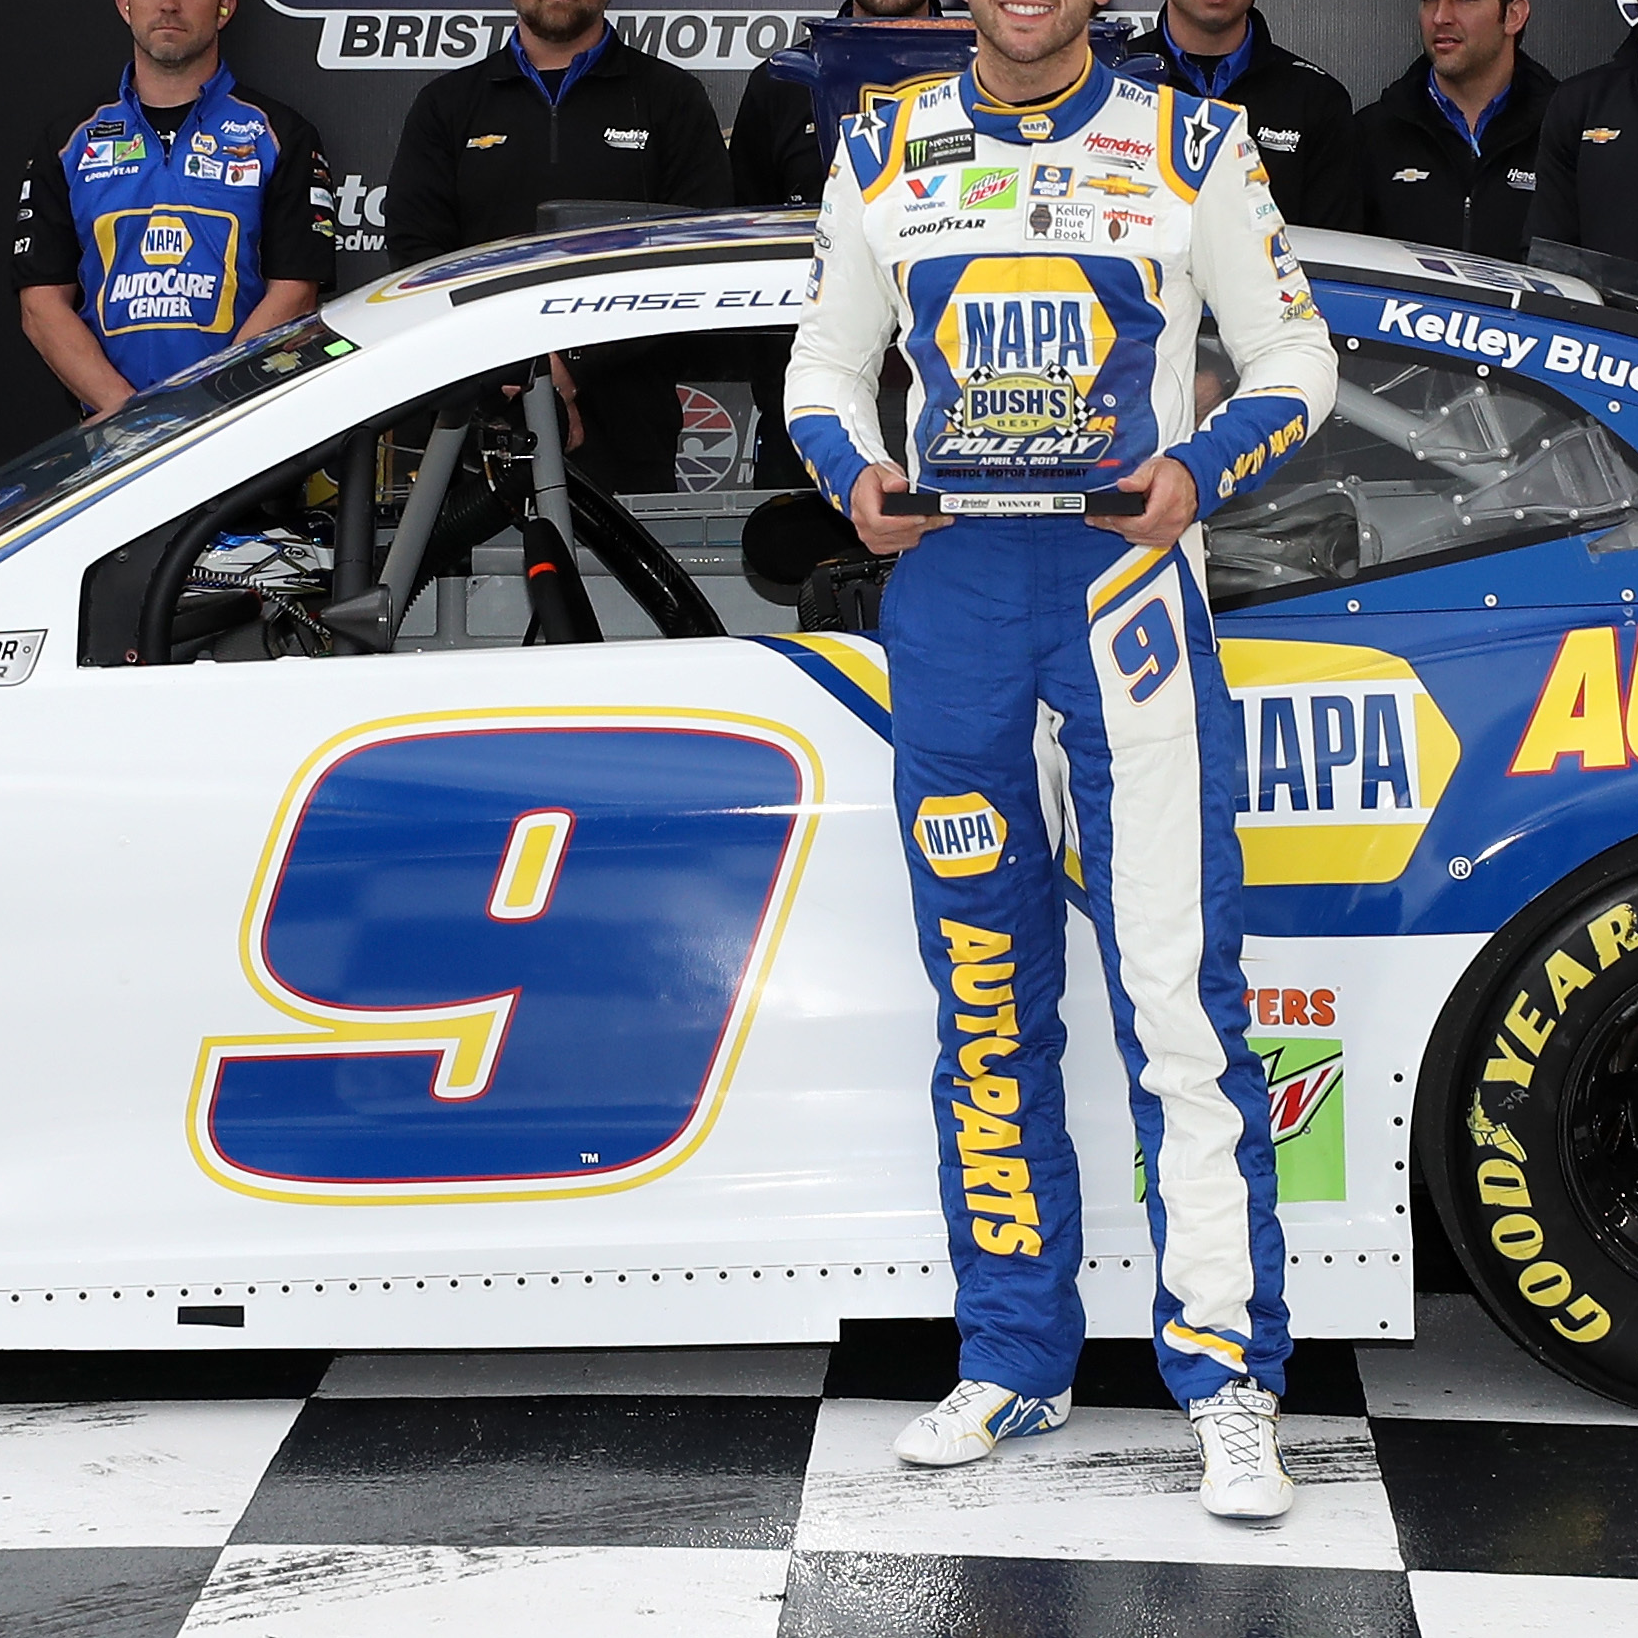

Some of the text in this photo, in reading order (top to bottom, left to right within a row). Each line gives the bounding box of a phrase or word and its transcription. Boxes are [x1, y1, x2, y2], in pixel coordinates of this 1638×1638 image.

[604, 128, 650, 142] Hendrick
[1021, 120, 1050, 133] NAPA
[1256, 127, 1302, 142] Hendrick
[1084, 132, 1155, 158] Hendrick
[903, 199, 947, 214] Valvoline
[1056, 204, 1093, 220] Kelley
[899, 216, 987, 238] GOODYEAR
[1055, 218, 1085, 230] Blue
[1102, 209, 1154, 227] HOOTERS
[145, 230, 184, 254] NAPA
[1054, 229, 1086, 241] Book
[128, 298, 193, 321] CENTER
[540, 291, 708, 317] CHASE
[963, 298, 1091, 370] NAPA
[1377, 298, 1539, 370] Kelley
[970, 387, 1068, 423] BUSH'S
[996, 418, 1040, 428] BEST
[935, 436, 1104, 456] POLE DAY
[978, 456, 1059, 466] APRIL 2019
[936, 467, 1089, 478] BRISTOL MOTOR SPEEDWAY
[996, 499, 1042, 509] WINNER
[1109, 594, 1181, 708] 9
[920, 810, 1000, 859] NAPA
[185, 705, 826, 1207] 9
[952, 1074, 1045, 1260] PARTS
